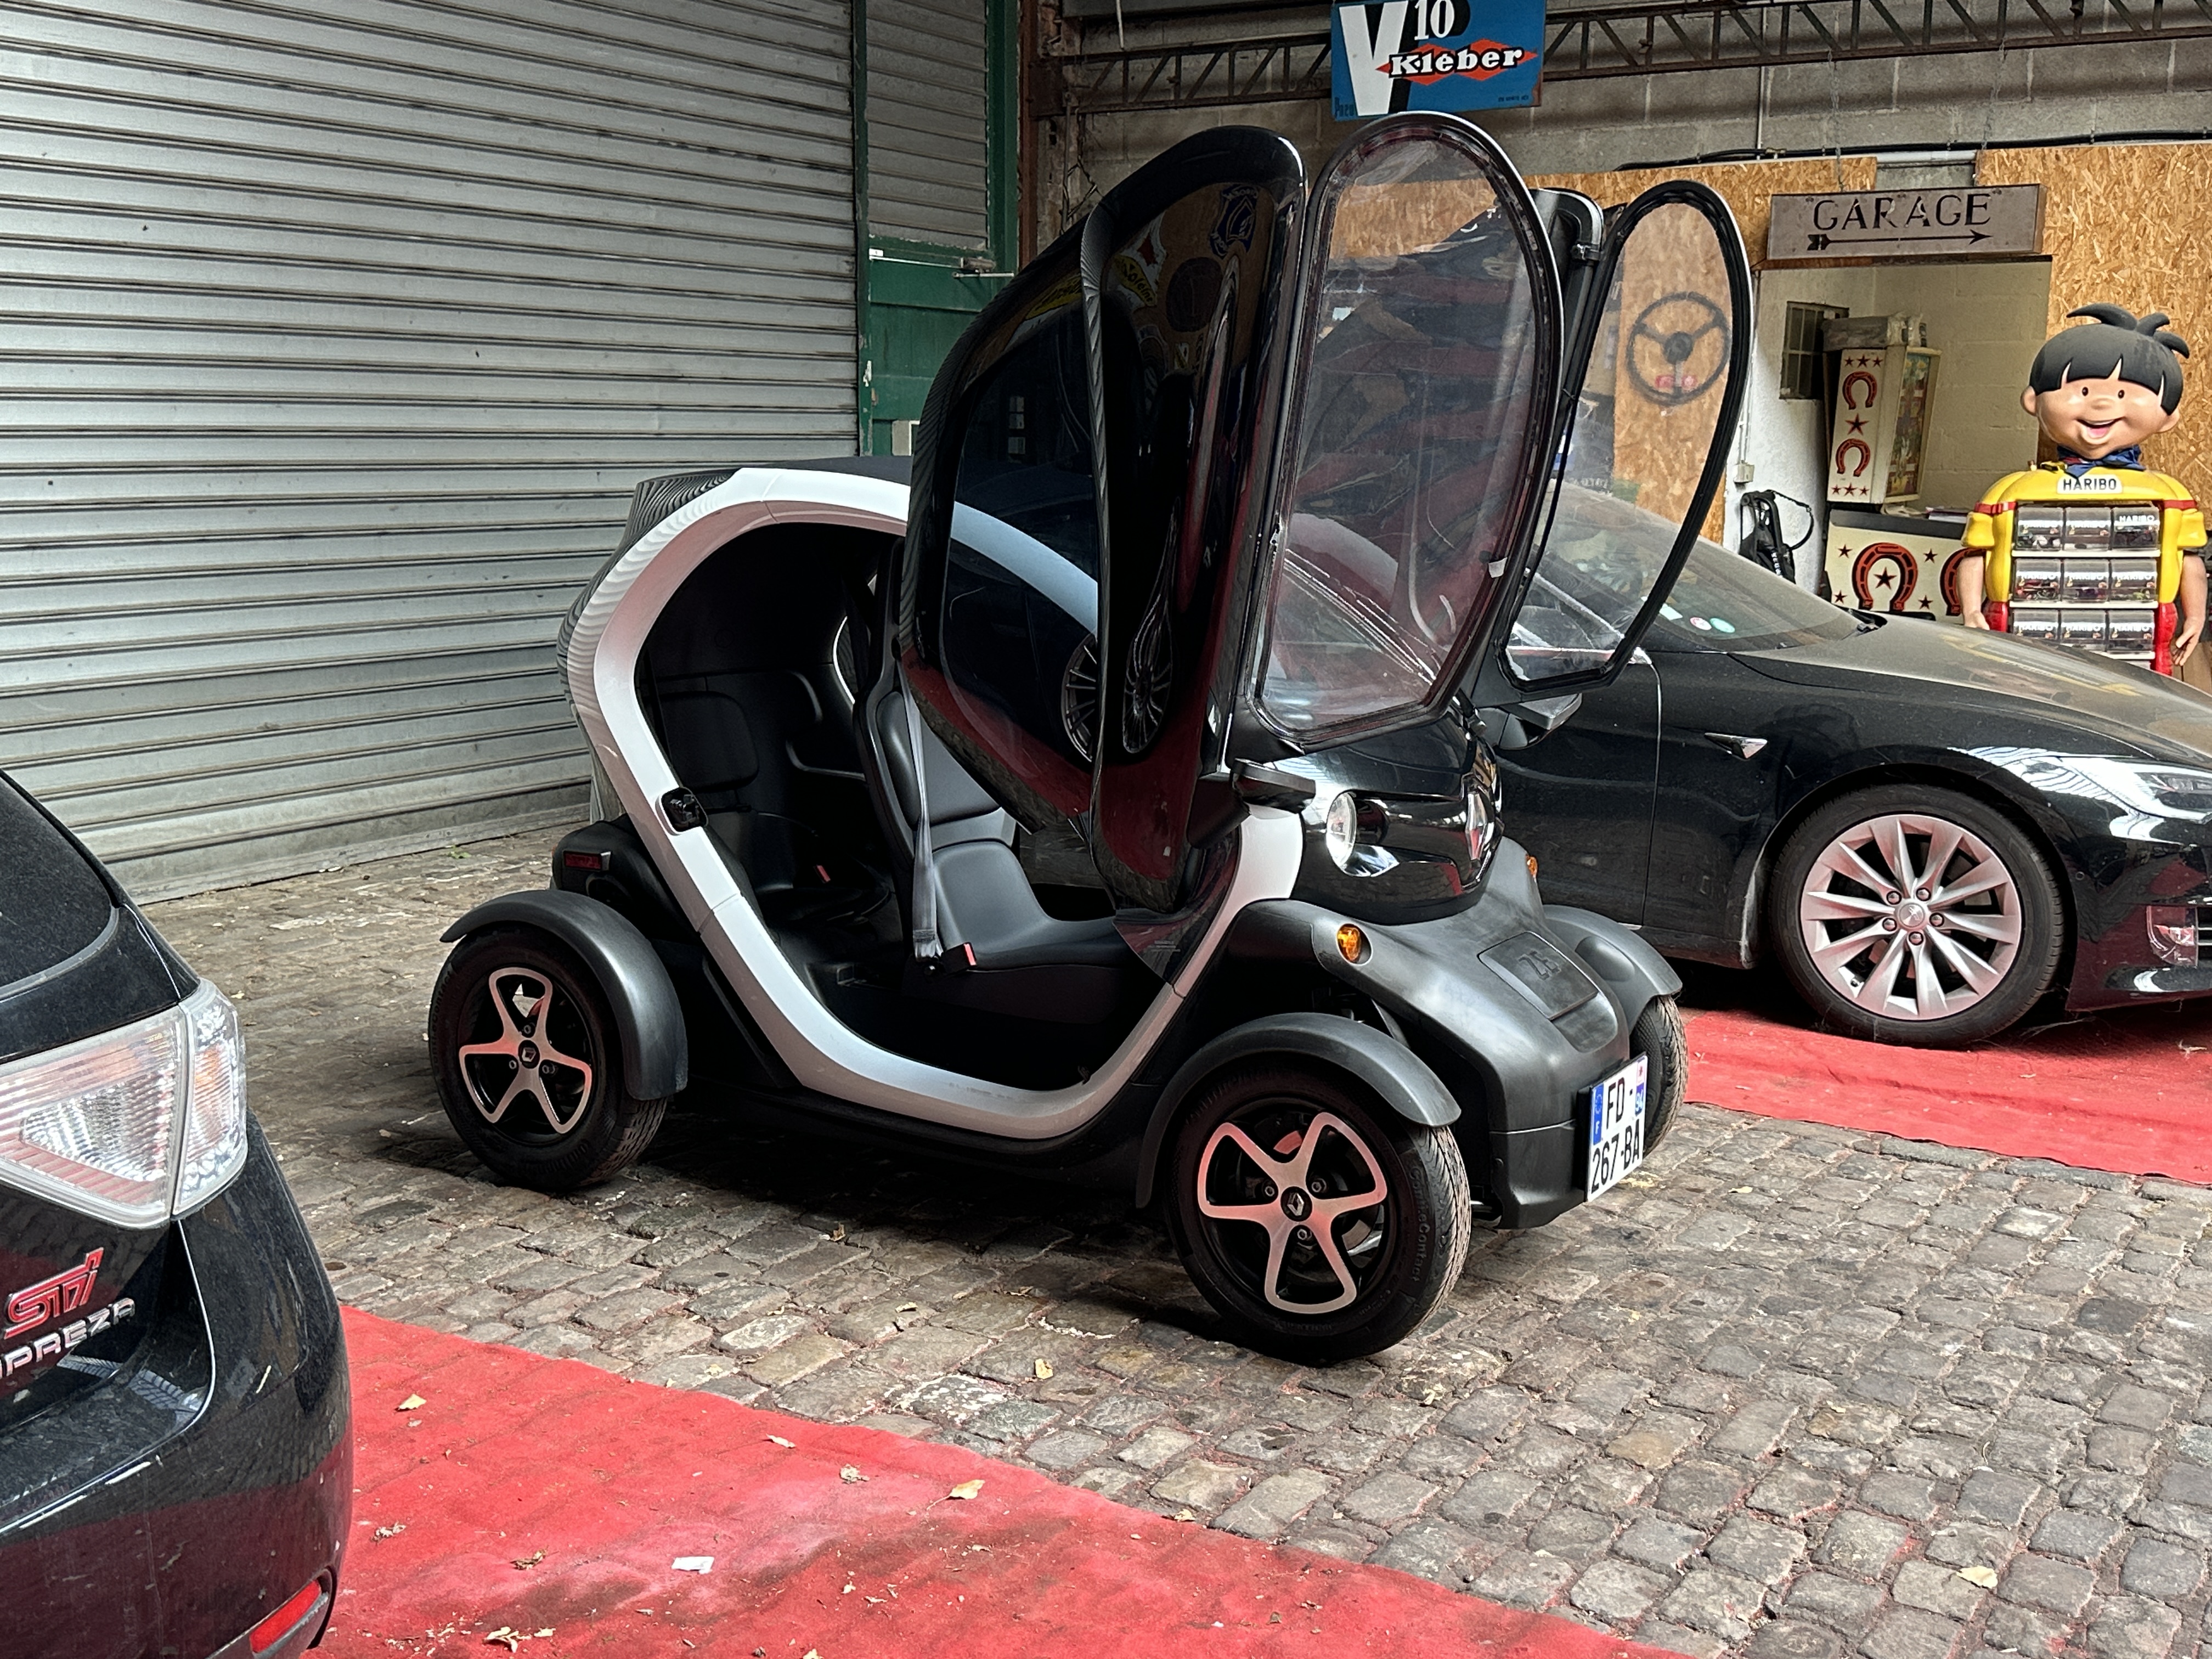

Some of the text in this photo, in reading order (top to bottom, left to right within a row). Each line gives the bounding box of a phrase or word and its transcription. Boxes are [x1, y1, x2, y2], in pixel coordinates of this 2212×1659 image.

[1814, 194, 1991, 230] GARAGE
[2063, 478, 2117, 491] HARIBO
[2119, 515, 2155, 523] HARIBO
